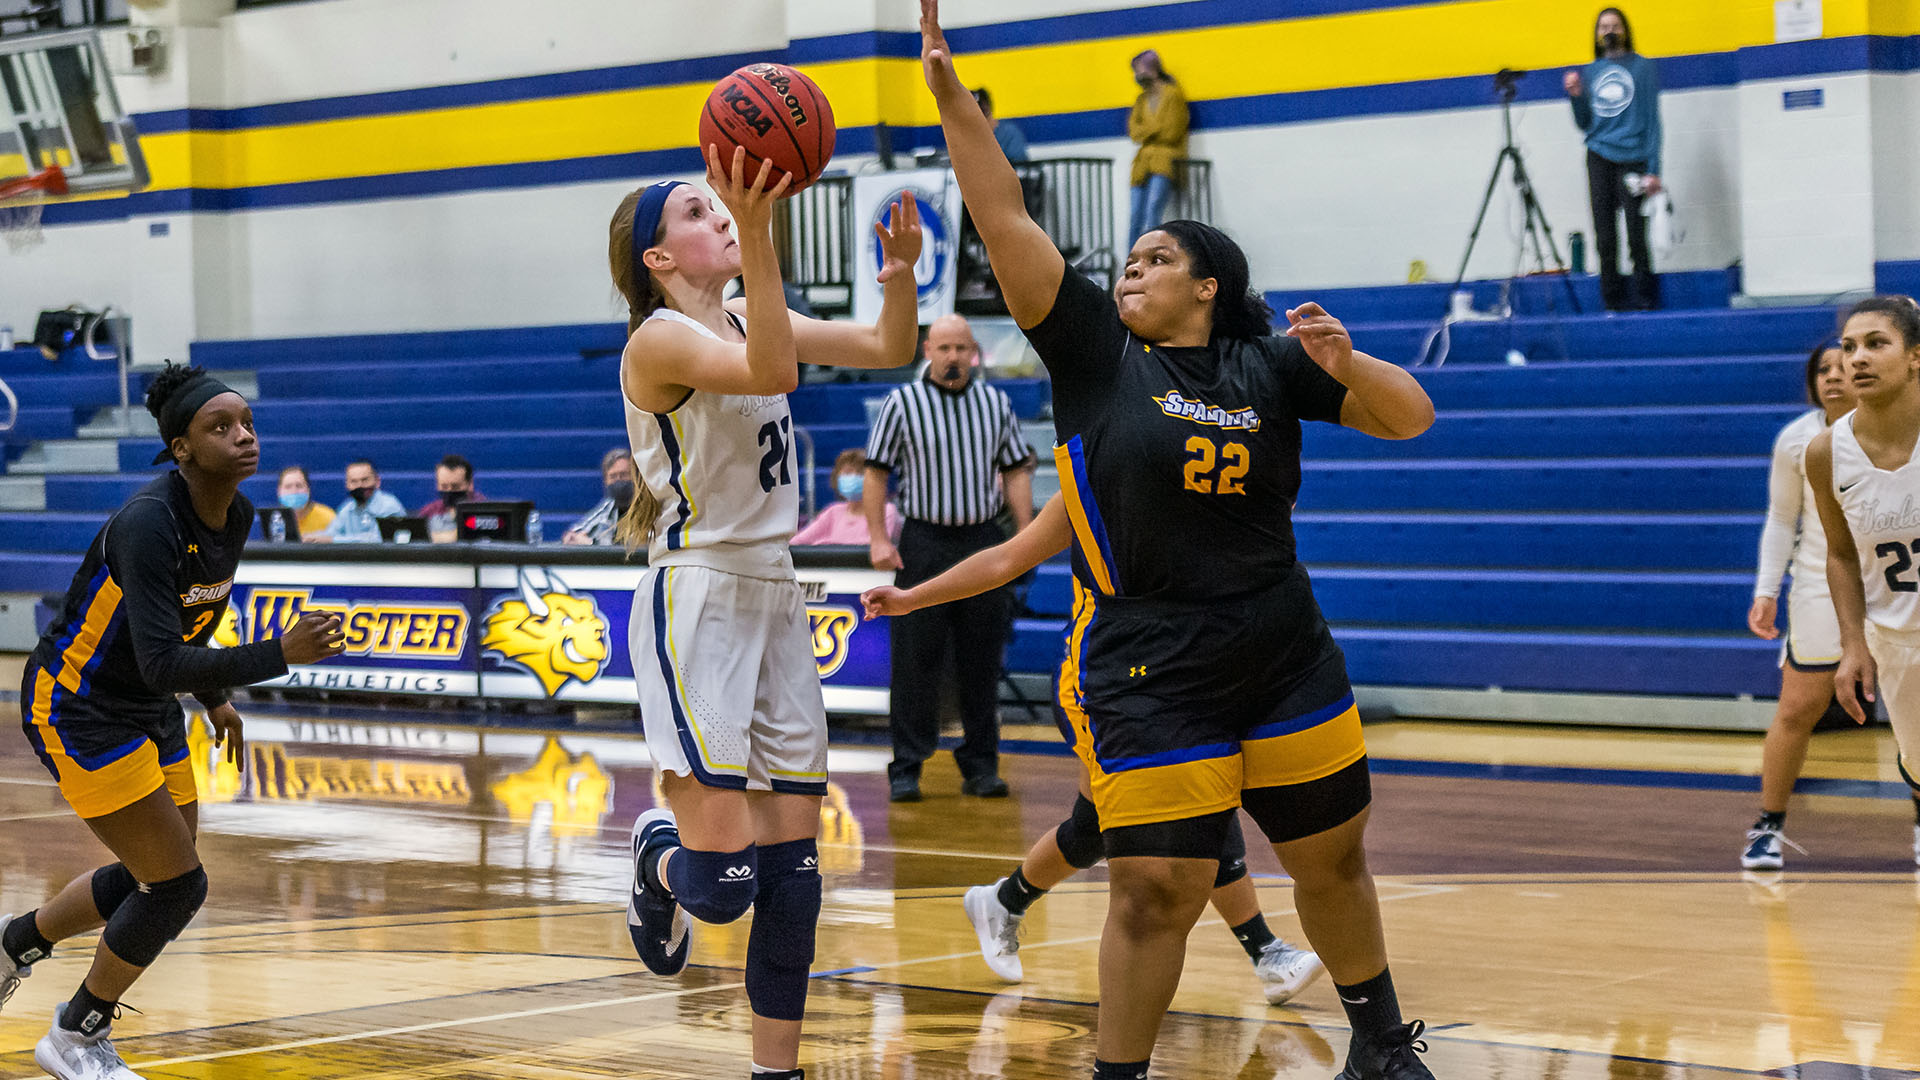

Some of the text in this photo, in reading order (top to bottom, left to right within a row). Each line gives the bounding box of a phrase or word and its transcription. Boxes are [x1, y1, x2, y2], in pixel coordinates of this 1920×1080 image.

[719, 83, 774, 138] NCAA
[1184, 436, 1250, 495] 22
[1875, 538, 1920, 592] 2
[250, 590, 468, 655] WSTER
[286, 671, 448, 692] ATHLETICS
